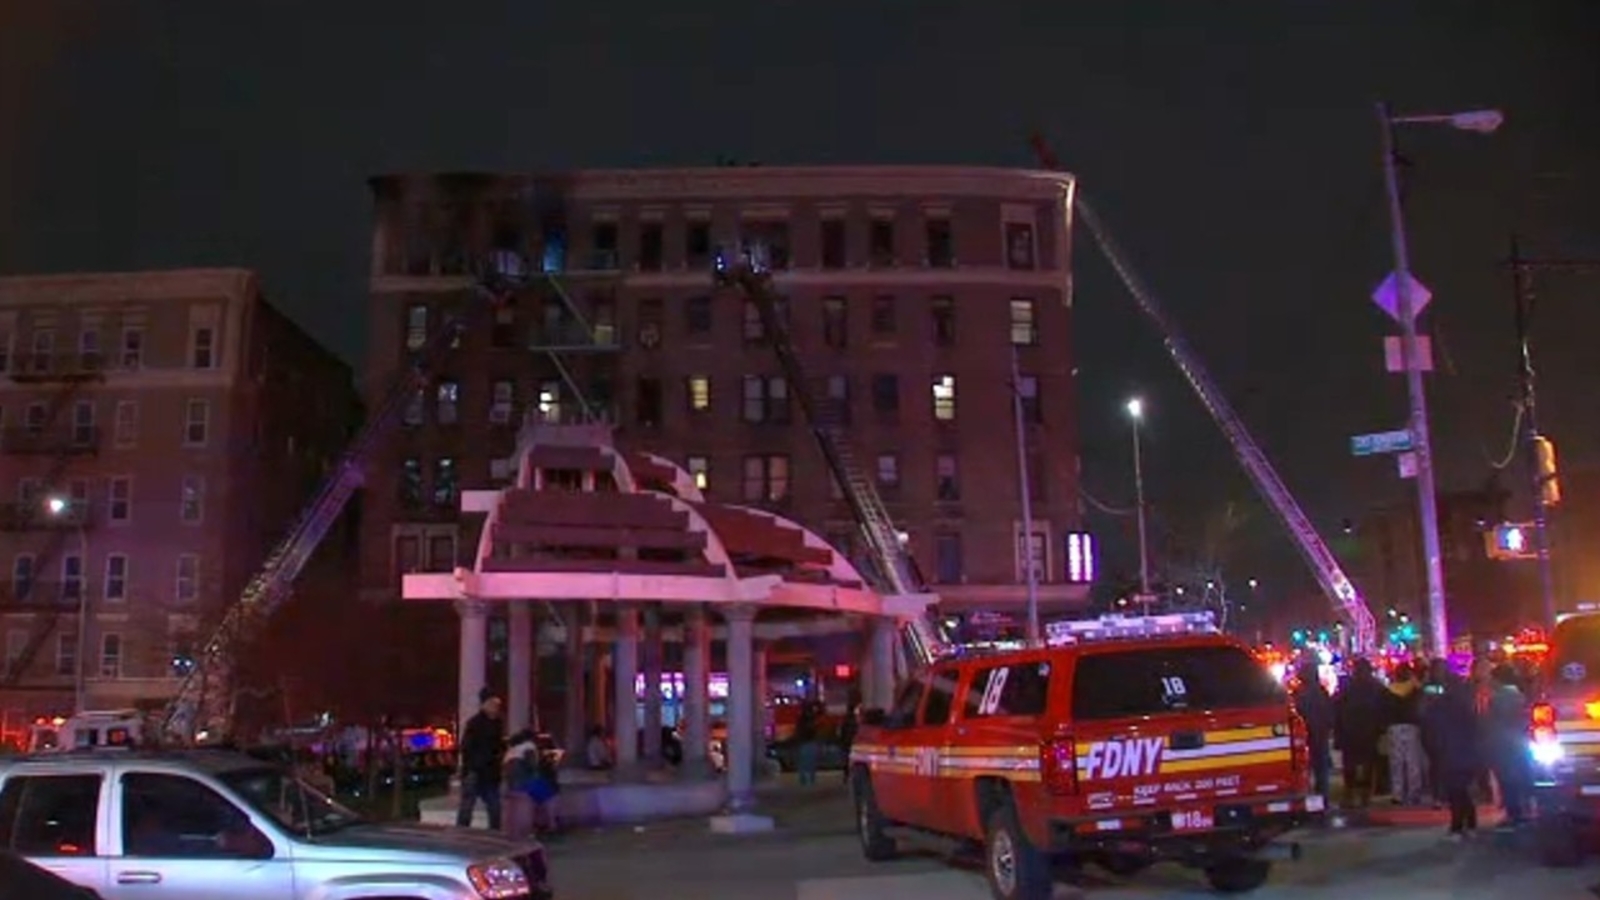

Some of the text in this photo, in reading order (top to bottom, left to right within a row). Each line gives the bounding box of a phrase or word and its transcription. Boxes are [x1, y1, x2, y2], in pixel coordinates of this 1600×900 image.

[978, 666, 1009, 715] 18
[1161, 676, 1186, 696] 18
[1086, 737, 1163, 780] FDNY
